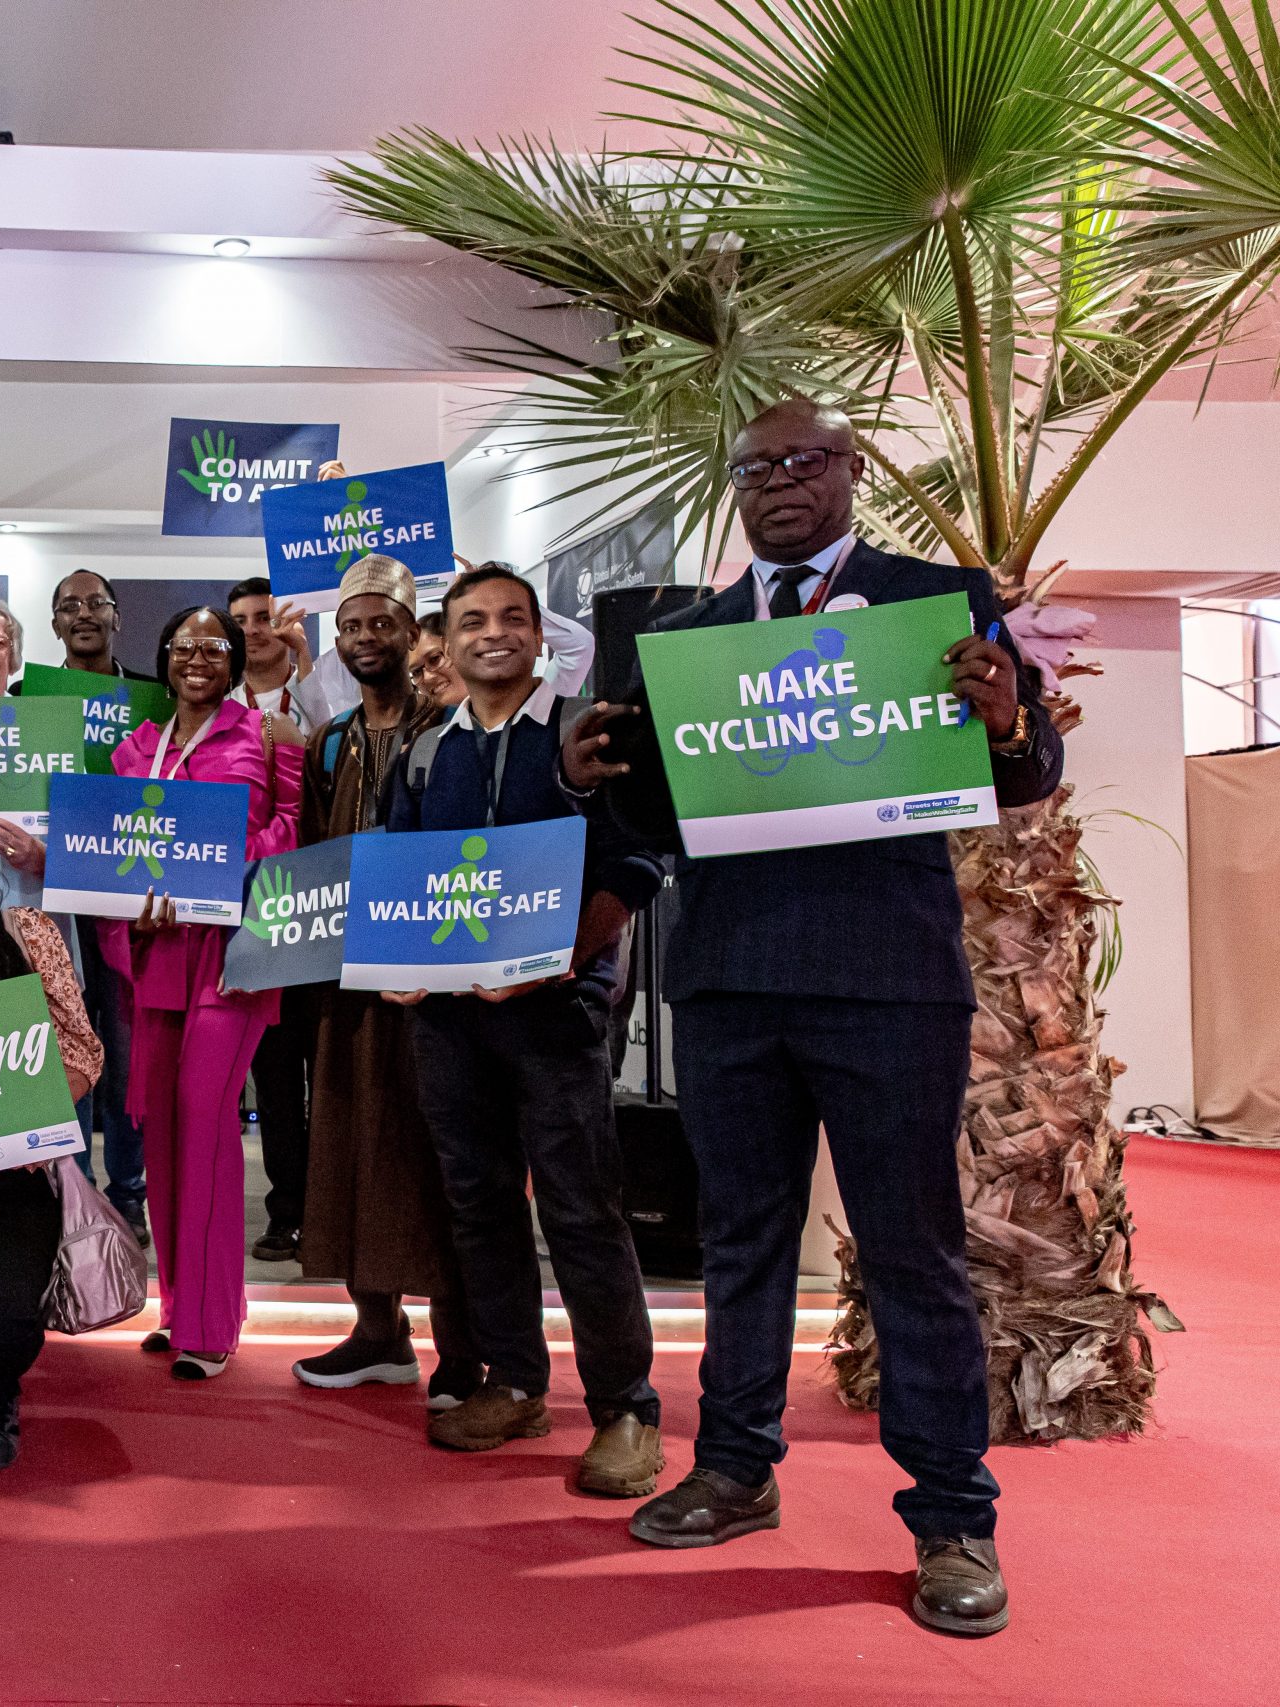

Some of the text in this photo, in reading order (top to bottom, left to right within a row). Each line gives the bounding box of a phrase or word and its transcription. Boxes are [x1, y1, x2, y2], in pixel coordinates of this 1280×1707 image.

[200, 457, 312, 479] COMMIT
[207, 482, 242, 503] TO
[323, 508, 384, 533] MAKE
[281, 522, 436, 561] WALKING SAFE
[738, 661, 859, 706] MAKE
[674, 692, 961, 756] CYCLING SAFE
[13, 753, 74, 774] SAFE
[112, 814, 177, 836] MAKE
[65, 834, 228, 863] WALKING SAFE
[426, 870, 502, 894] MAKE
[260, 880, 351, 921] COMMI
[369, 888, 562, 922] WALKING SAFE
[267, 911, 348, 947] TO AC
